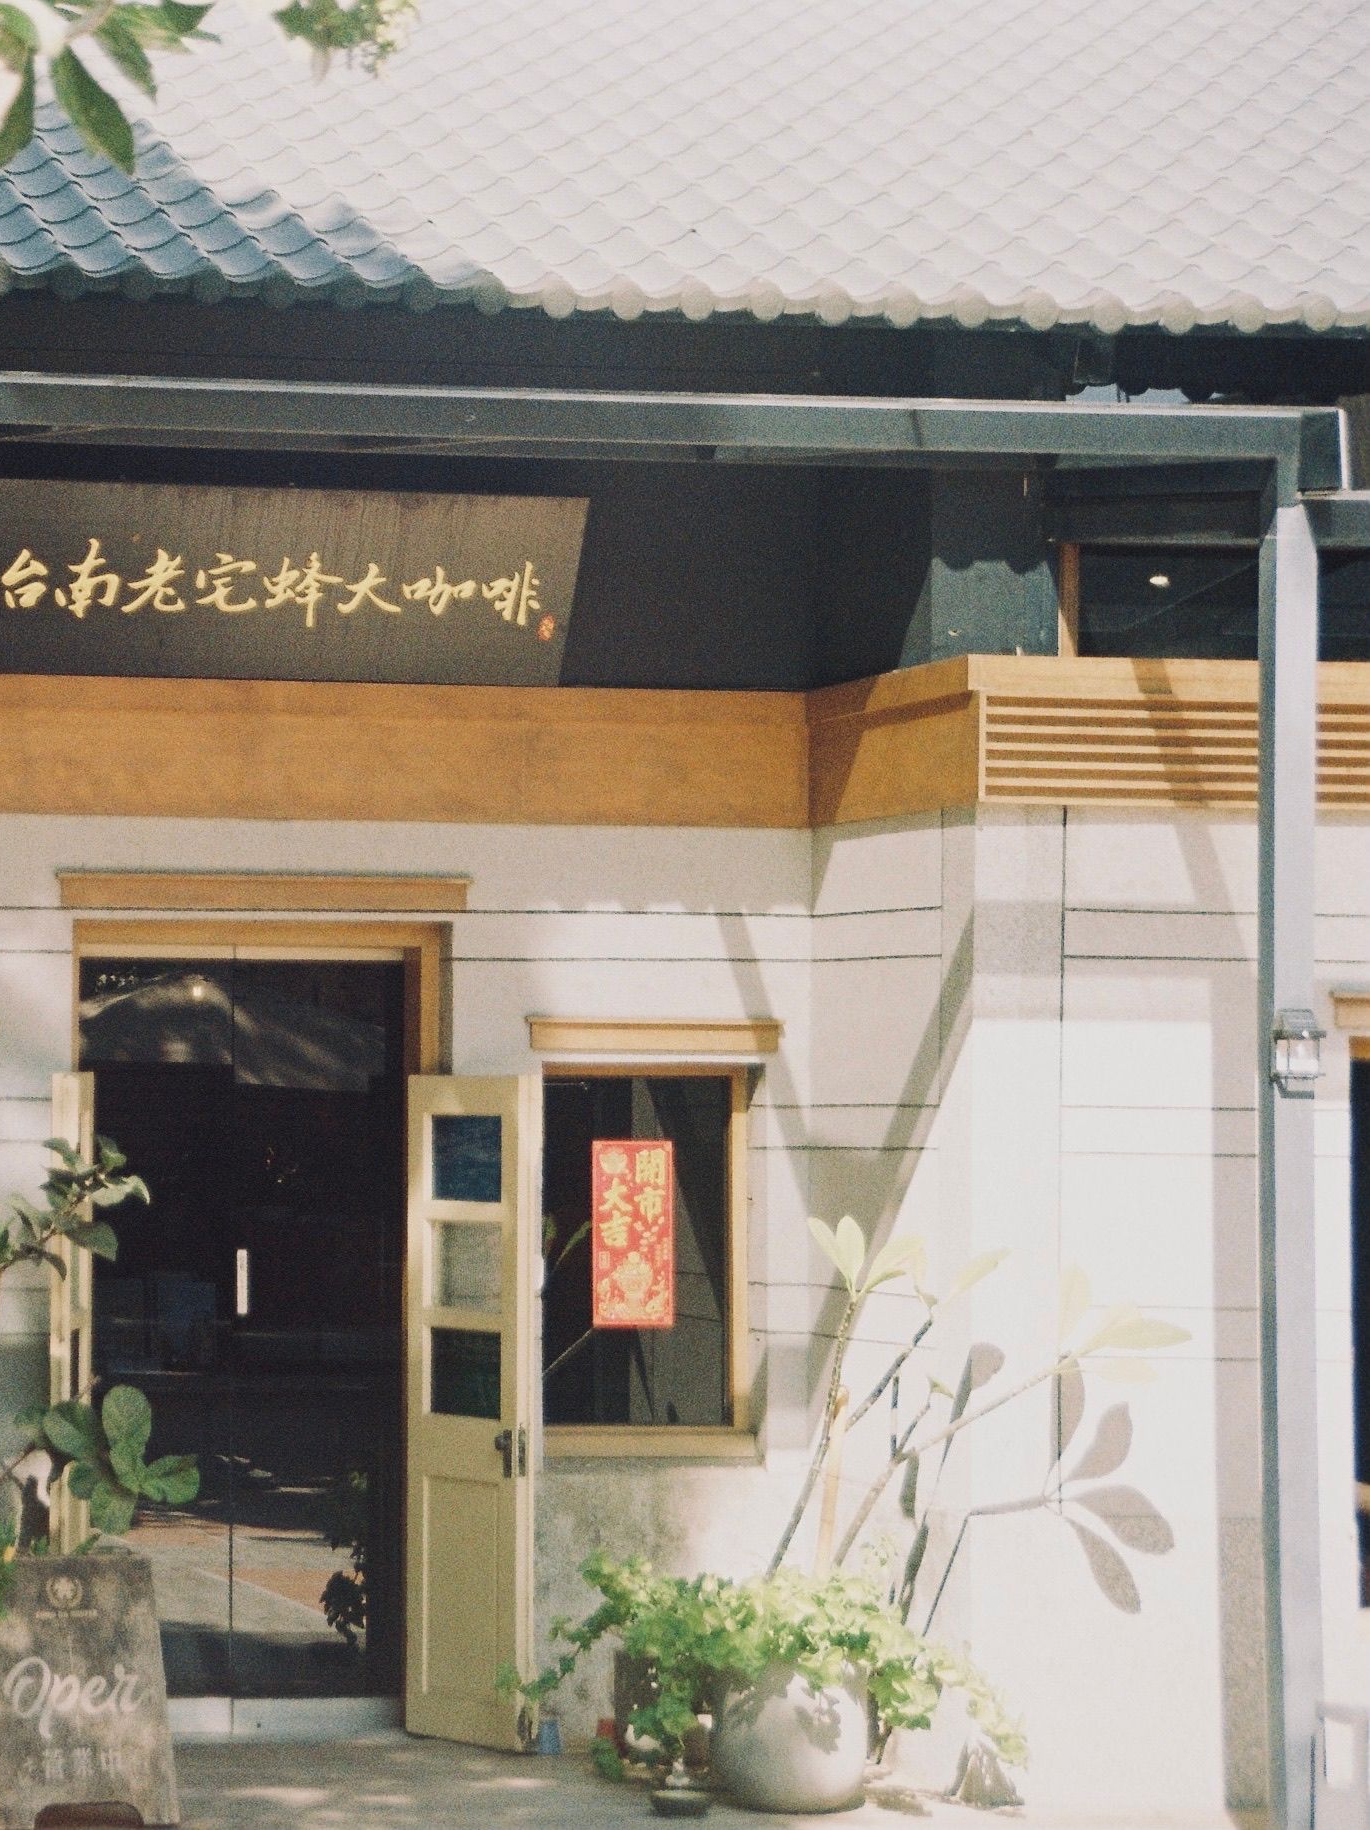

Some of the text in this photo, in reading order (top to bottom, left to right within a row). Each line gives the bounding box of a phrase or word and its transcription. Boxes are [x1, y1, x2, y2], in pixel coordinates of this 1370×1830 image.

[0, 538, 541, 628] 台南老宅蜂大咖啡
[598, 1177, 633, 1249] 大吉
[634, 1148, 667, 1225] 開市
[3, 1656, 150, 1741] Open
